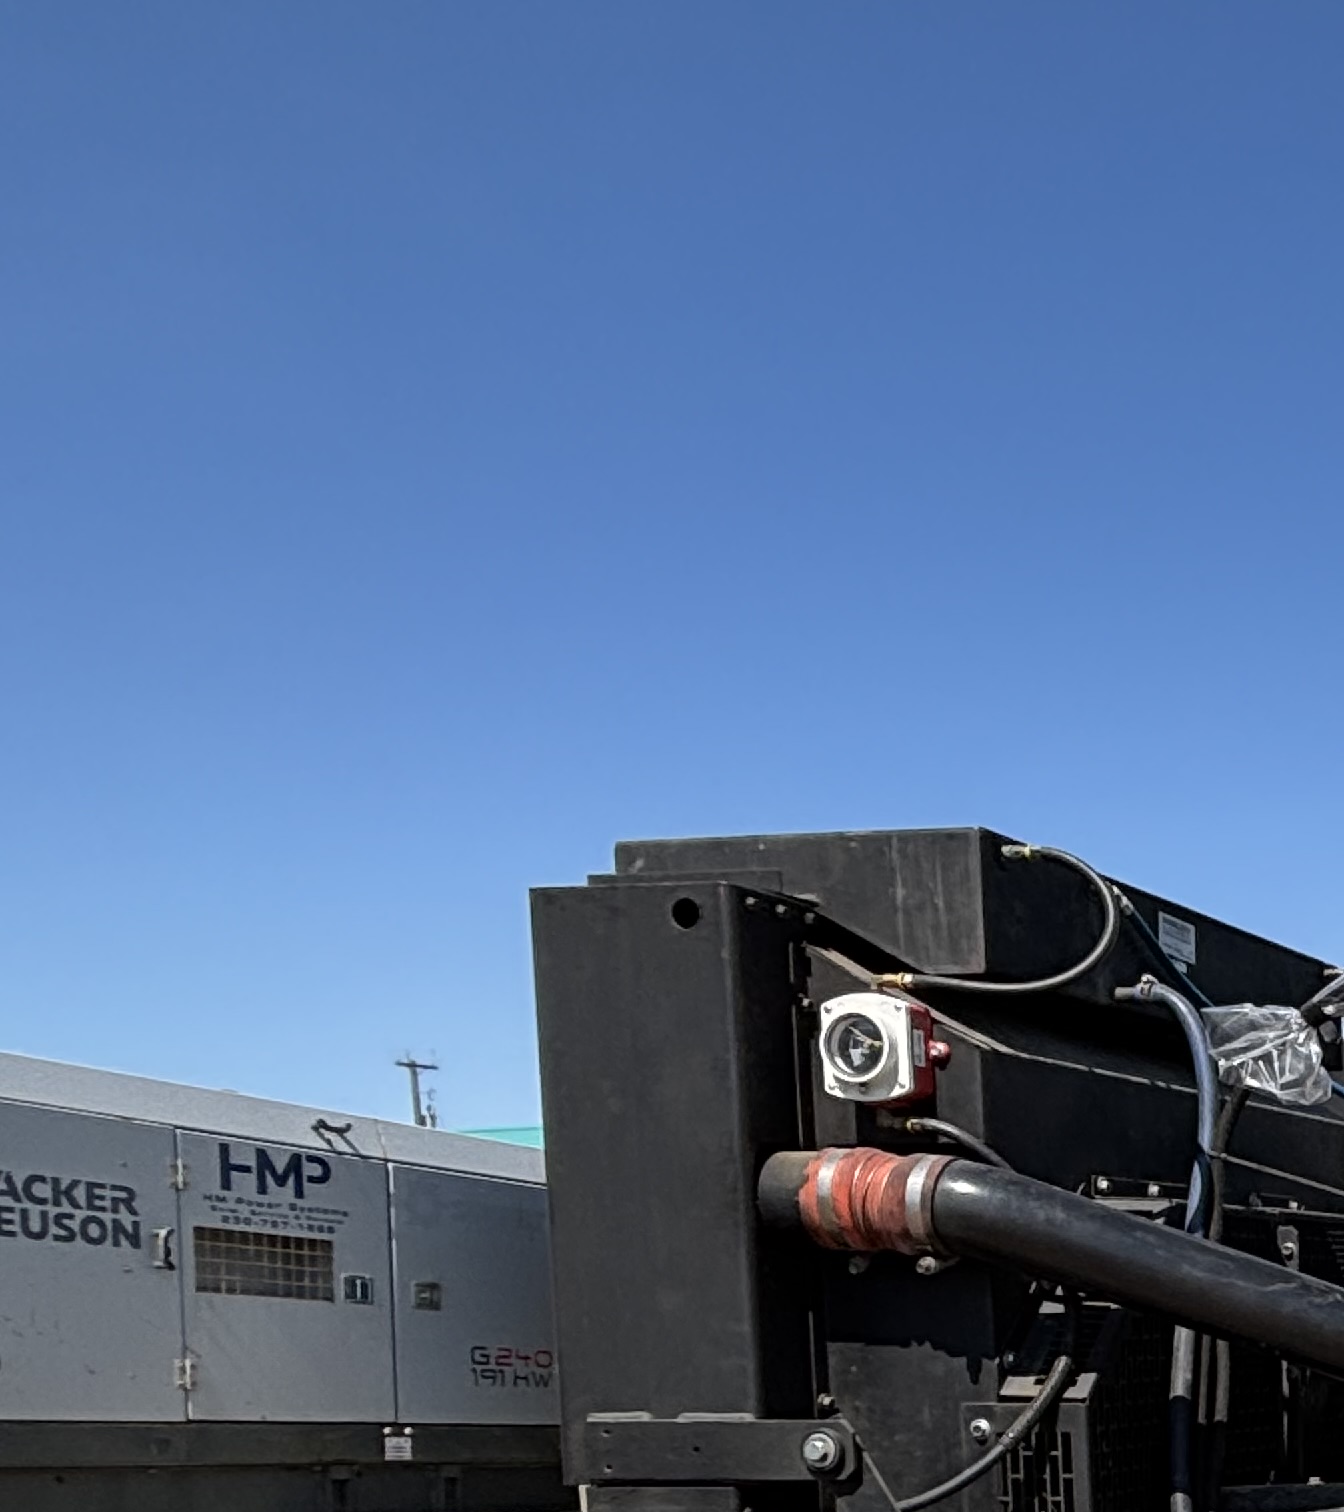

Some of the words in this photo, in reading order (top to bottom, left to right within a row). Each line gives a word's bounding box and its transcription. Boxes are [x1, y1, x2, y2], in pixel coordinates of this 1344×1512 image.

[218, 1143, 332, 1199] HMP
[0, 1206, 142, 1249] EUSON
[471, 1346, 553, 1368] G240
[470, 1367, 506, 1388] 191
